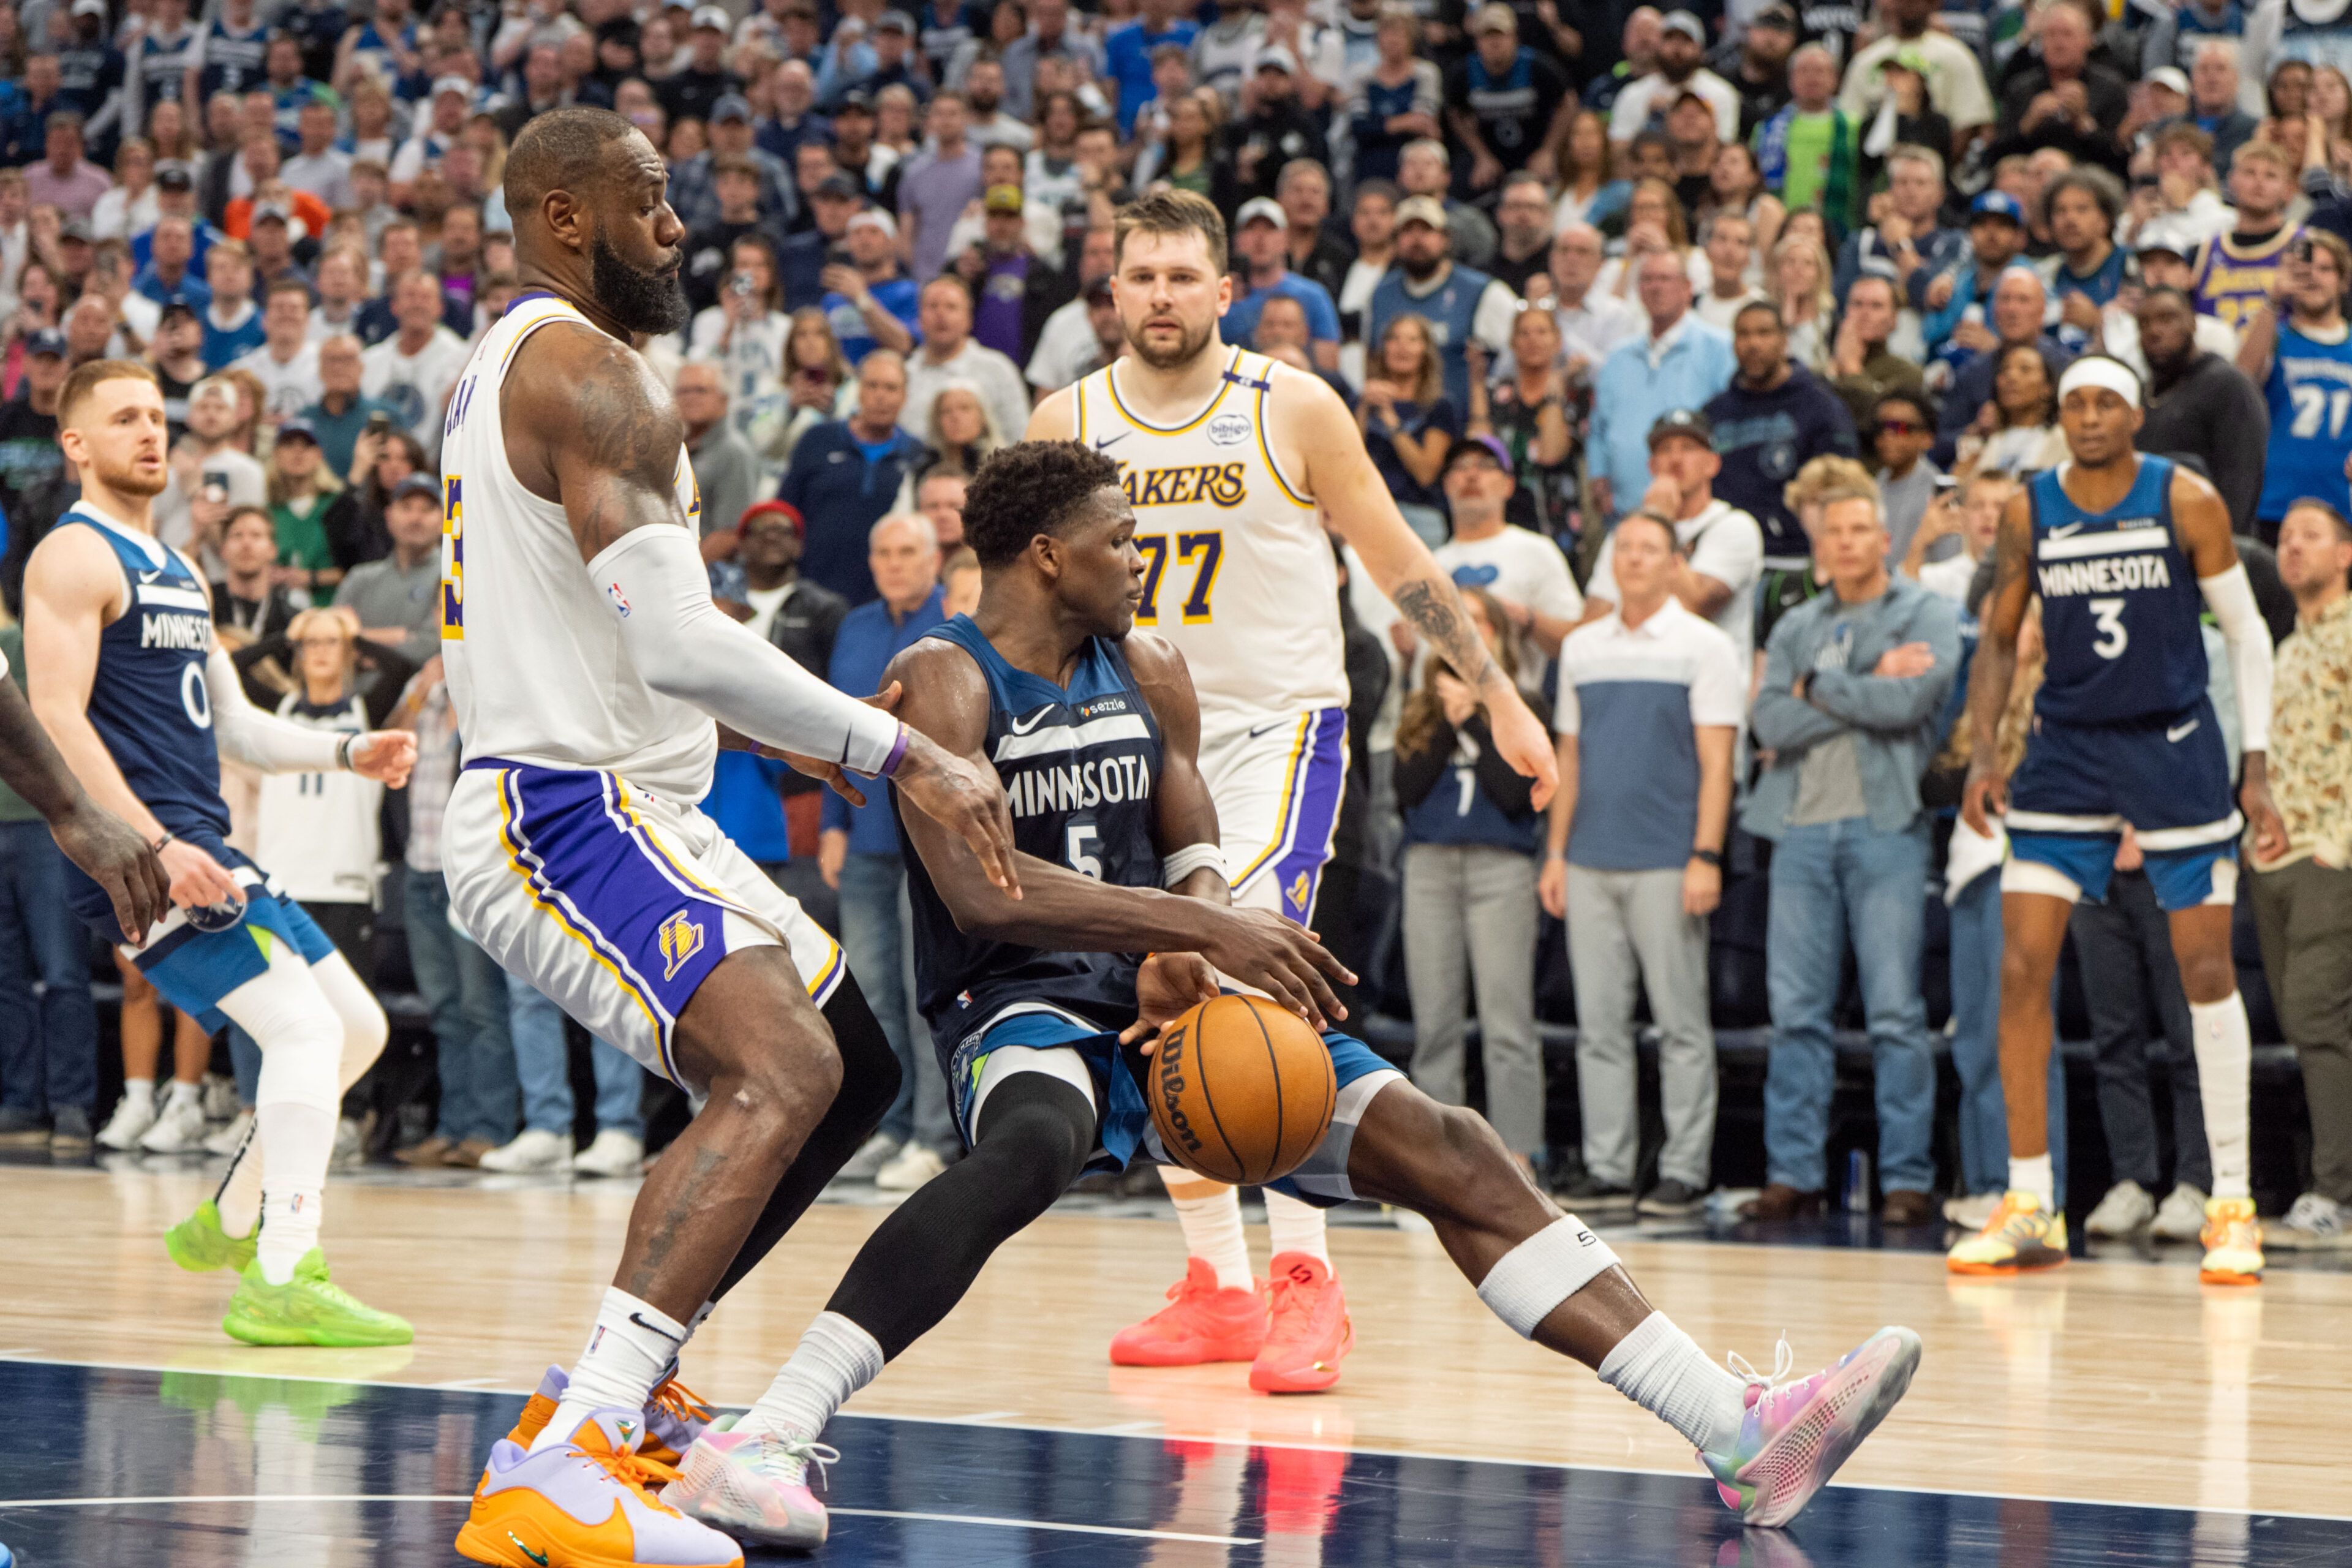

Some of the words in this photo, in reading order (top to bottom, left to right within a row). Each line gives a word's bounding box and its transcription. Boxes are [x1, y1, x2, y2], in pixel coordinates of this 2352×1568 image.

[1212, 423, 1249, 434] bibigo
[2290, 384, 2351, 439] 21
[1117, 461, 1247, 510] AKERS
[1132, 529, 1224, 625] 77
[2038, 554, 2171, 598] MINNESOTA
[2089, 597, 2128, 660] 3
[181, 661, 212, 729] 0
[1090, 698, 1126, 714] sezzle
[1067, 824, 1102, 882] 5
[1161, 1024, 1202, 1152] Wilson
[1577, 1231, 1596, 1247] 5
